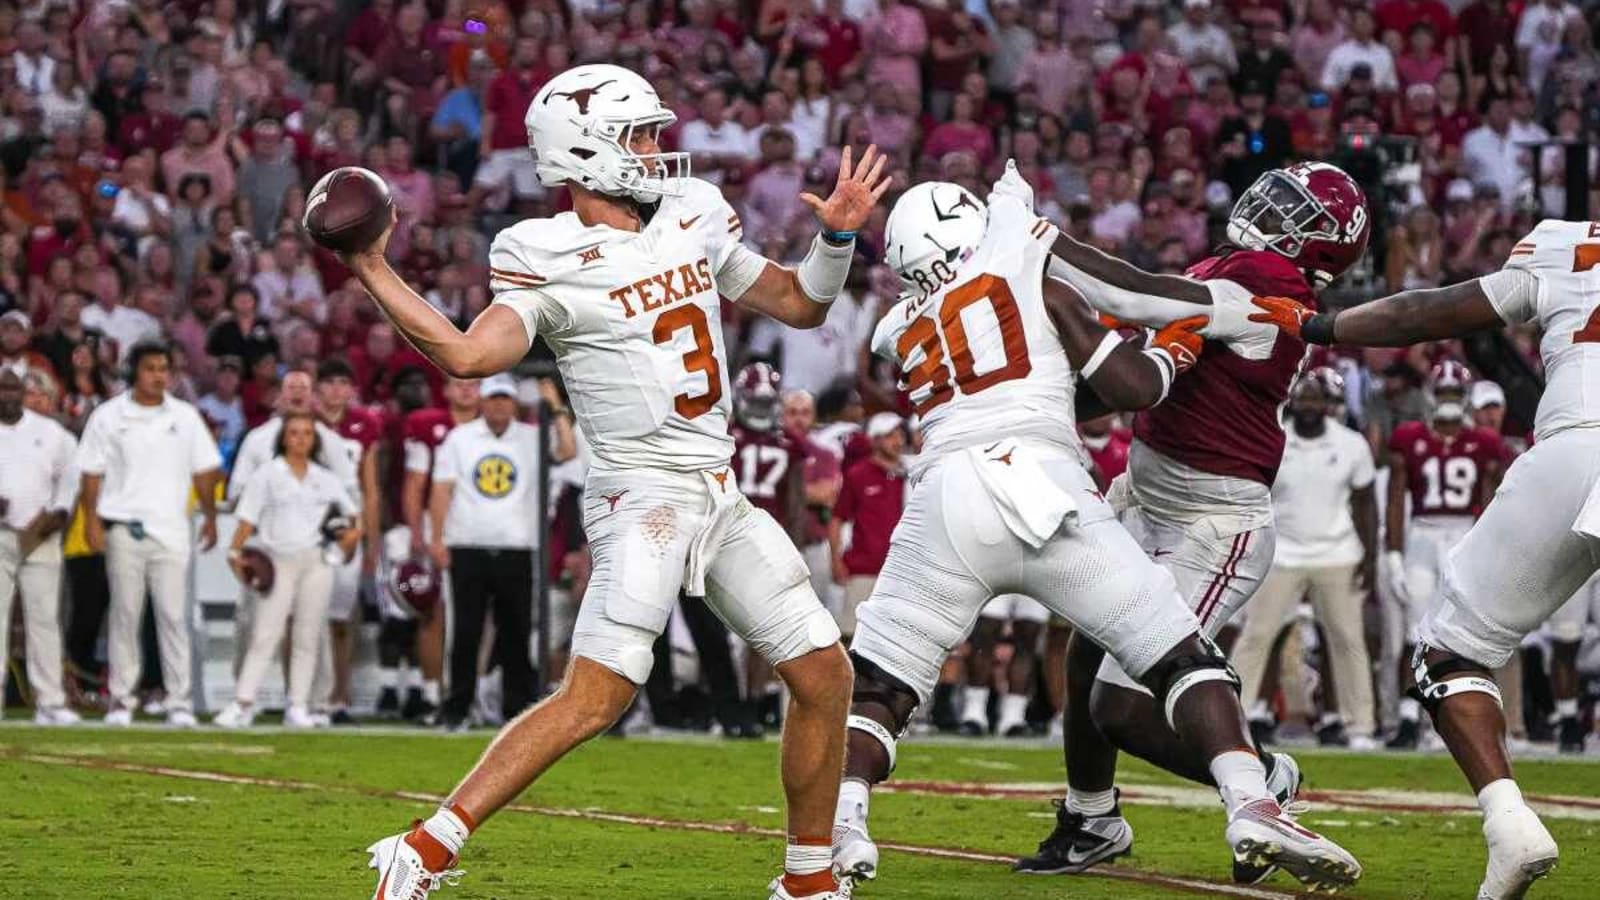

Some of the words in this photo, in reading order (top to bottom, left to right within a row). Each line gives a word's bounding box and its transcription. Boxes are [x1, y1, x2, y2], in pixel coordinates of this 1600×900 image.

[609, 257, 713, 318] TEXAS
[652, 302, 722, 420] 3
[740, 444, 789, 497] 17
[1422, 456, 1478, 508] 19
